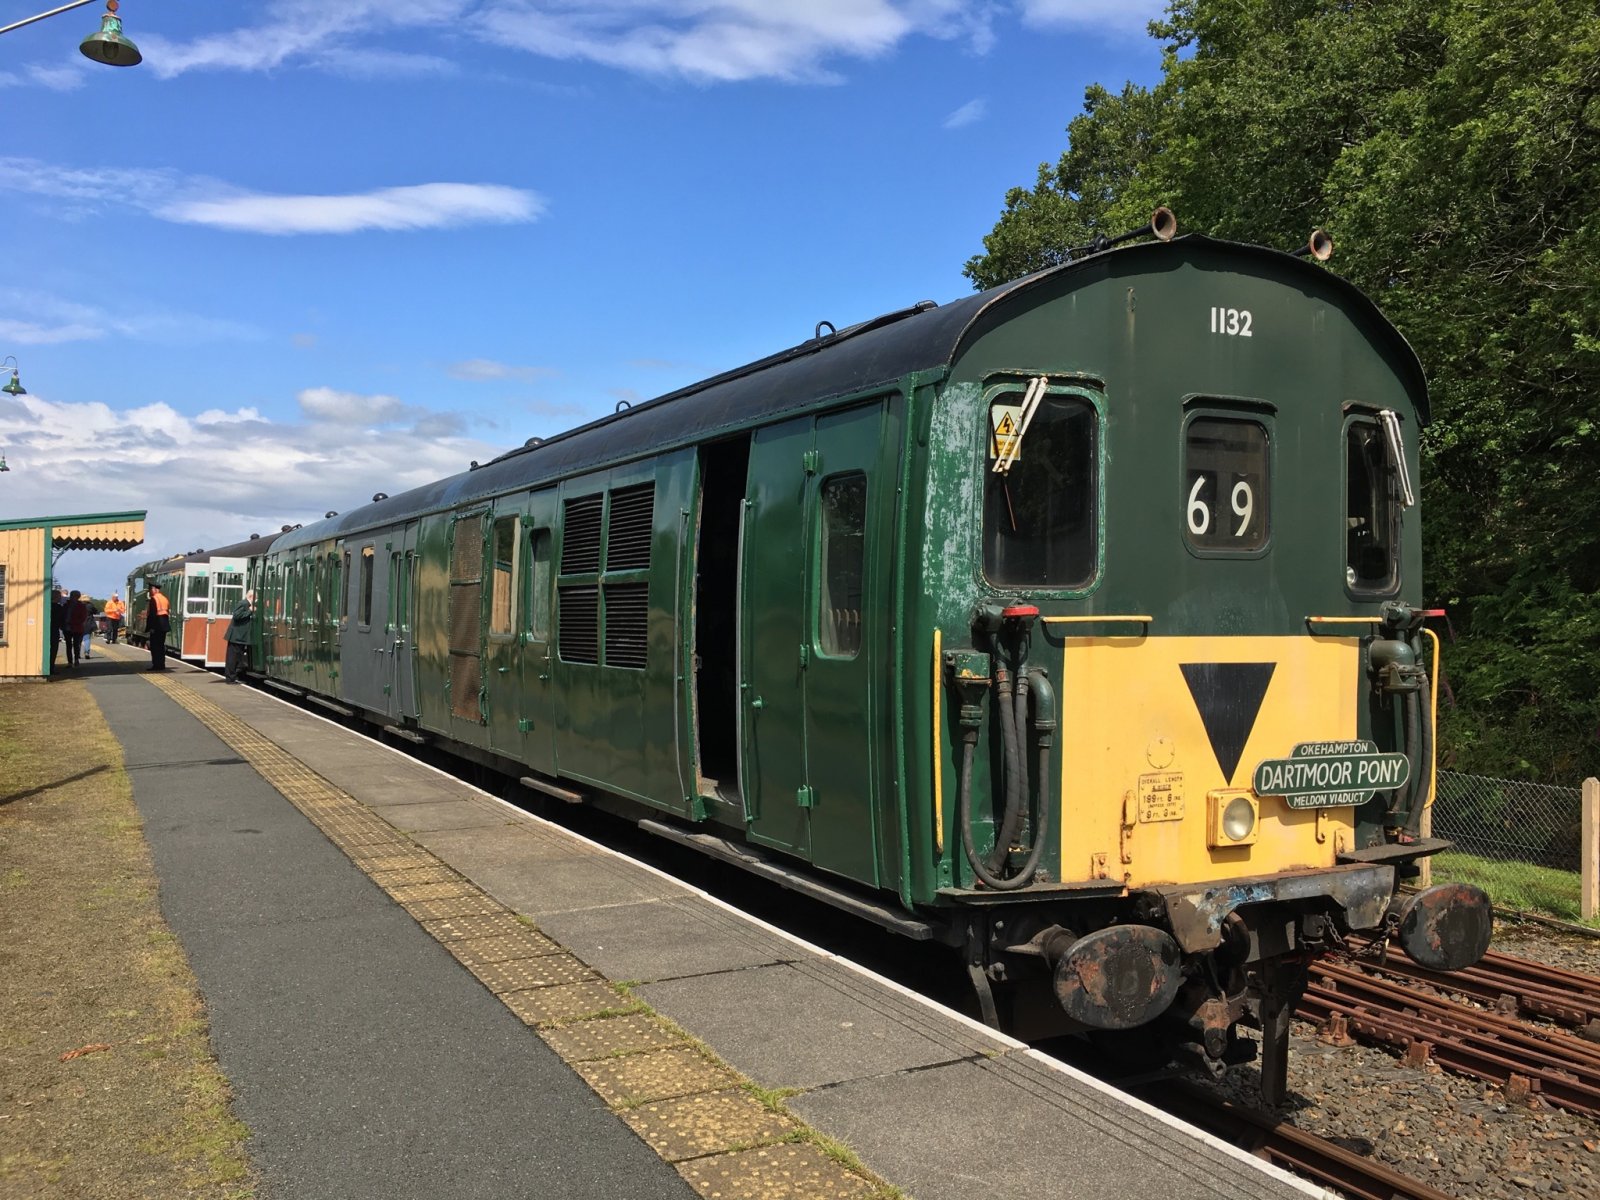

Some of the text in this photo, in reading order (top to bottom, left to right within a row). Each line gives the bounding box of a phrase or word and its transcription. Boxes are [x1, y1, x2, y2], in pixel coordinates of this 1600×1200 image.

[1211, 307, 1253, 337] 1132
[1300, 742, 1369, 756] OKEHAMPTON
[1260, 759, 1403, 791] DARTMOOR PONY
[1293, 792, 1365, 807] MELDON VIADUCT
